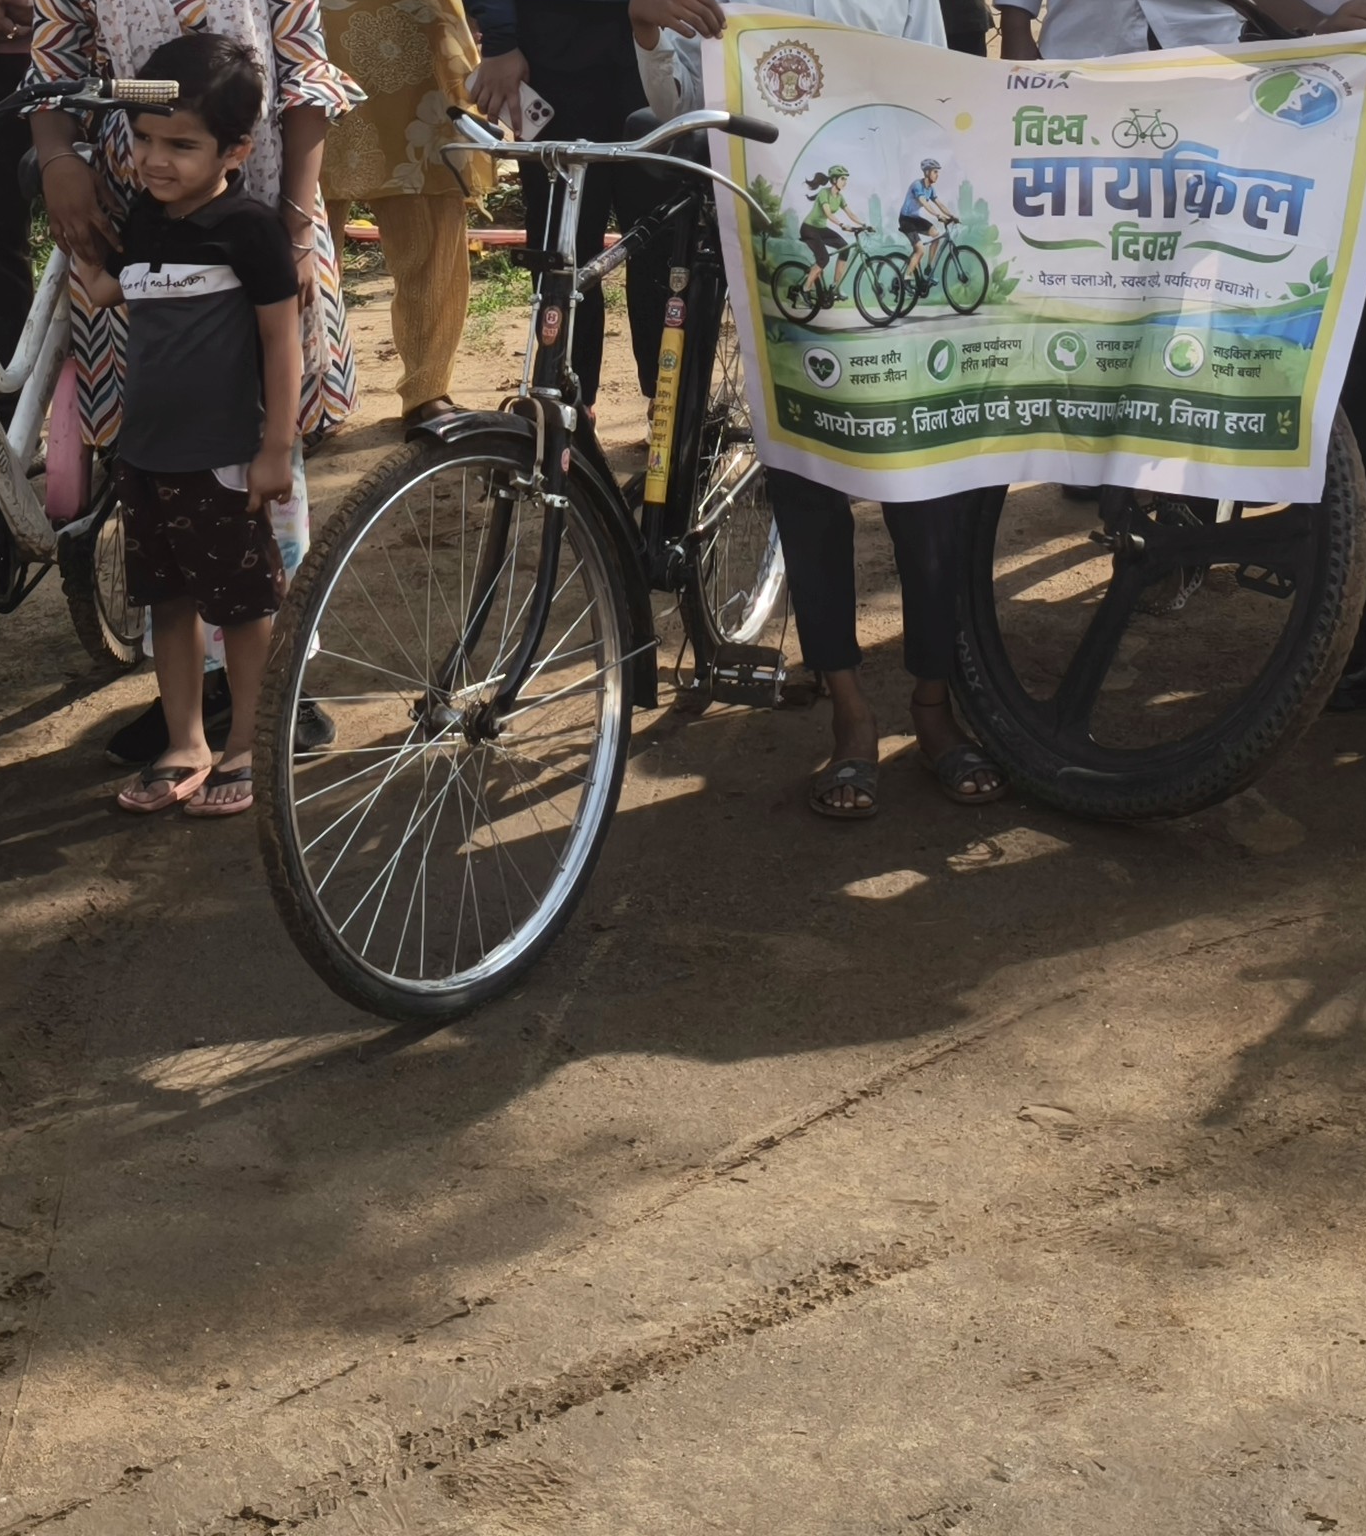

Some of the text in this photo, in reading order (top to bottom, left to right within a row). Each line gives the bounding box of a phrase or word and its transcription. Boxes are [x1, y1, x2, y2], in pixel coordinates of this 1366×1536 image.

[1012, 105, 1088, 147] विश्व
[1011, 141, 1315, 237] सायकिल
[1109, 221, 1182, 261] दिवस
[1071, 271, 1117, 289] चलाओ,
[1164, 272, 1211, 290] पर्यावरण
[984, 337, 1022, 353] पर्यावरण
[1213, 345, 1251, 361] साइकिल
[849, 350, 902, 368] स्वस्थ शरीर
[961, 358, 979, 375] हरित
[850, 368, 908, 388] सशक्त जीवन
[1212, 362, 1234, 379] पृथ्वी
[814, 410, 897, 438] आयोजक
[912, 407, 948, 433] जिला
[951, 400, 980, 426] खेल
[985, 396, 1010, 421] एवं
[1016, 398, 1052, 425] युवा
[1057, 399, 1115, 421] कल्याण
[1170, 398, 1218, 430] जिला
[1224, 411, 1266, 434] हरदा
